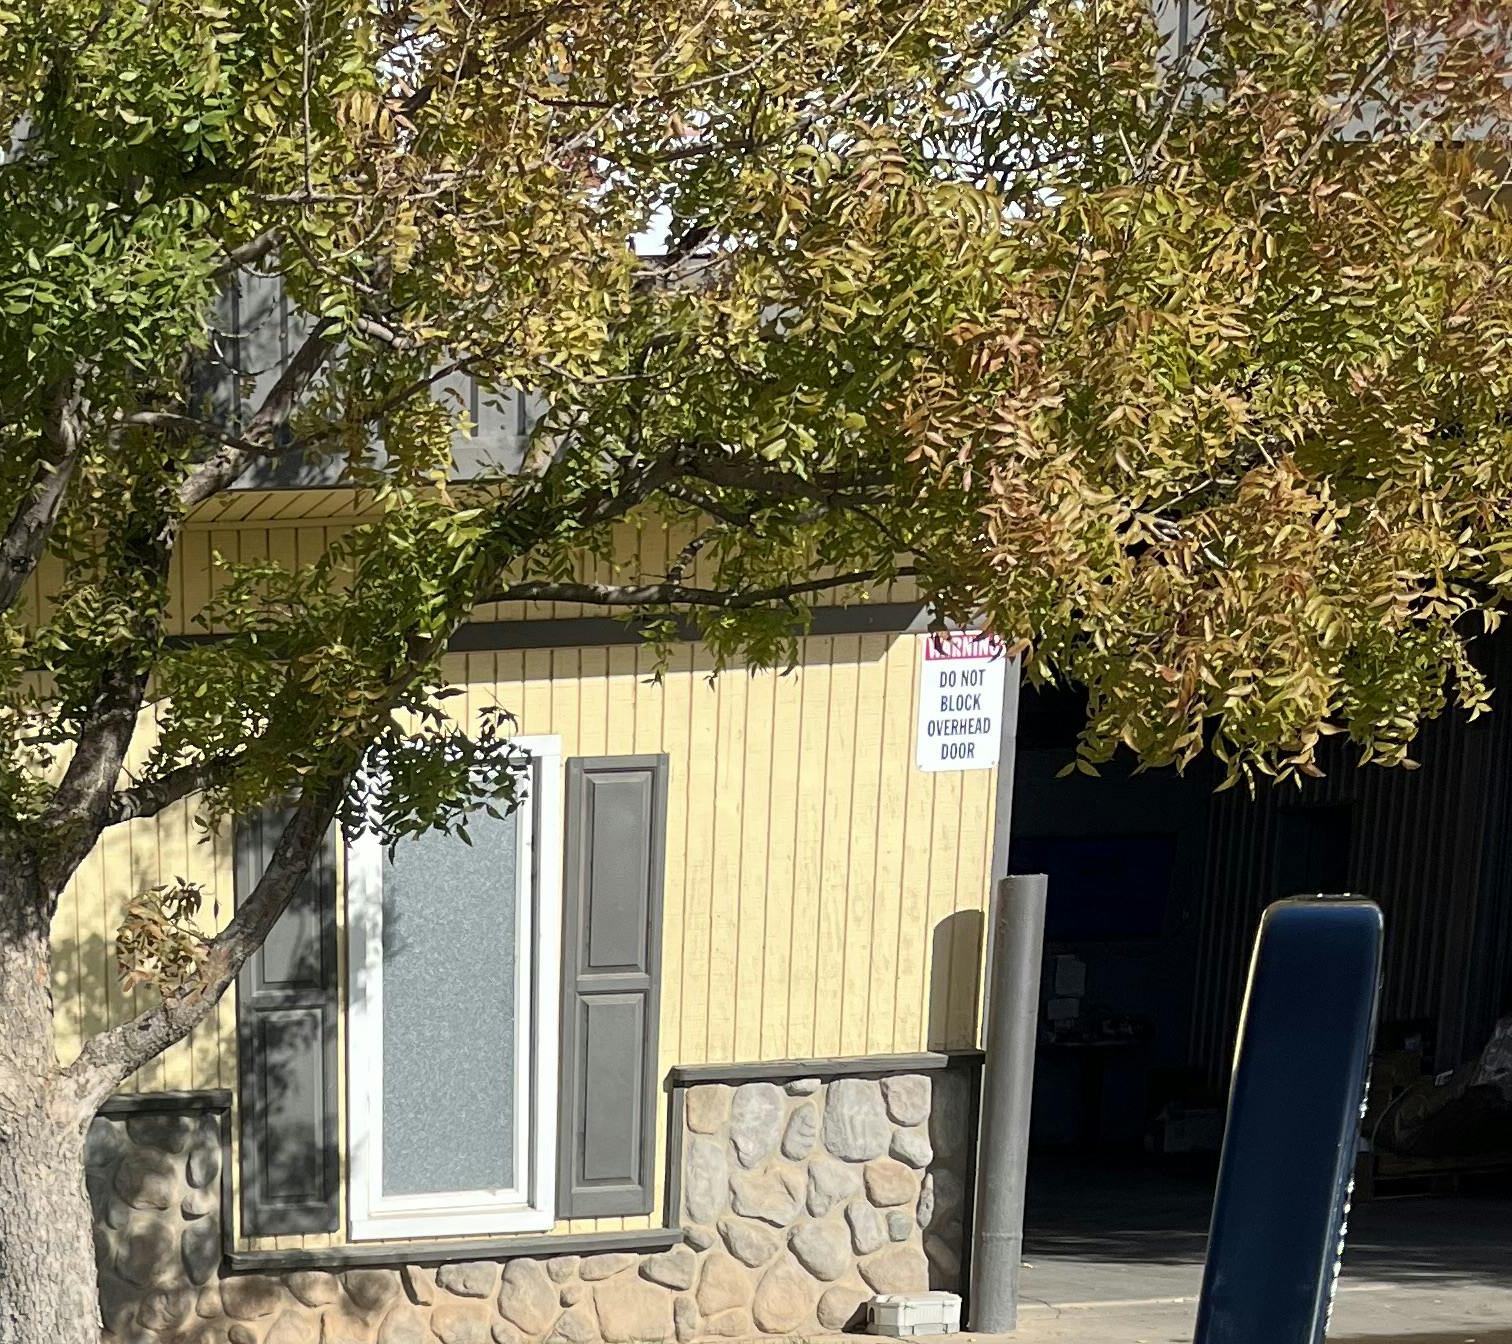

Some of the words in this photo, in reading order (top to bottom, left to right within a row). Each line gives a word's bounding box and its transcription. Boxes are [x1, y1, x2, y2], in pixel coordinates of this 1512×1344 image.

[940, 670, 956, 687] DO
[961, 669, 986, 686] NOT
[941, 694, 981, 712] BLOCK
[928, 717, 991, 737] OVERHEAD
[941, 743, 975, 760] DOOR
